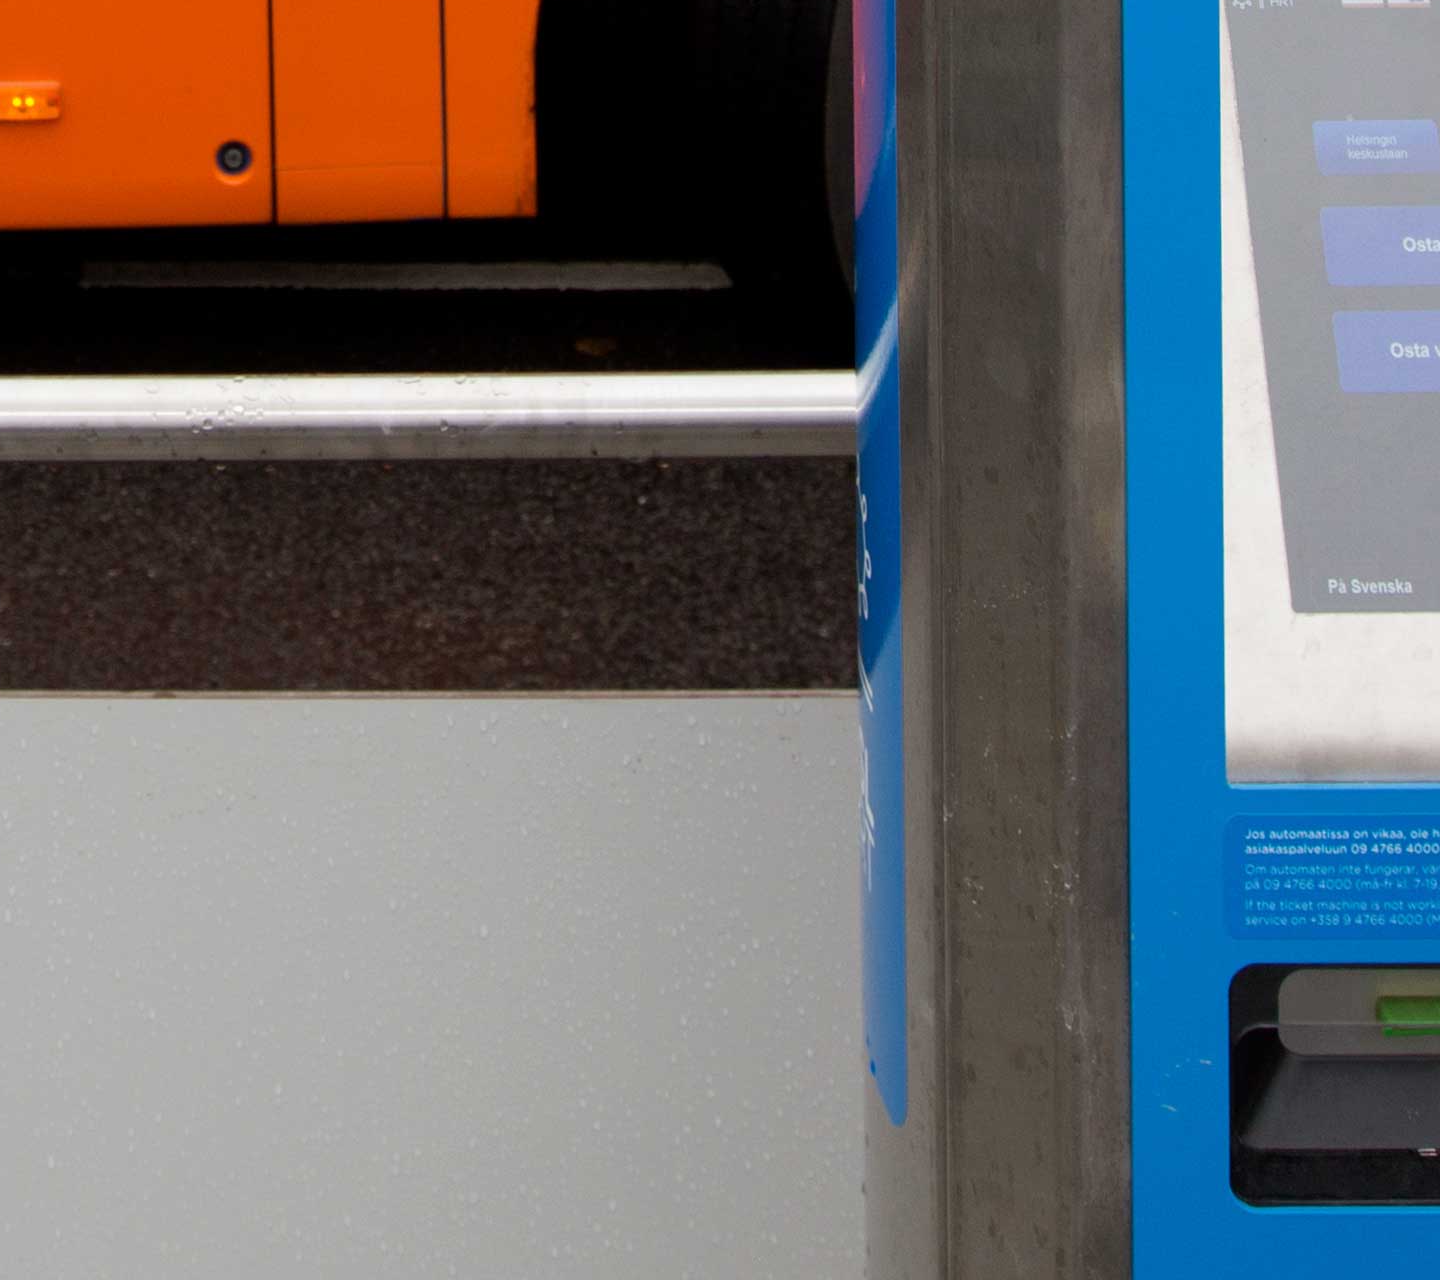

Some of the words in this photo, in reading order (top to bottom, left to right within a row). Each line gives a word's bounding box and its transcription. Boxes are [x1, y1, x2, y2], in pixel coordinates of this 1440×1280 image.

[1346, 135, 1397, 148] Helsingin
[1347, 149, 1408, 160] keskustaan
[1390, 342, 1430, 358] Osta
[1351, 579, 1413, 594] Svenska
[1245, 829, 1265, 841] Jos
[1270, 829, 1349, 841] automaatissa
[1353, 828, 1369, 840] on
[1411, 828, 1428, 840] ole
[1245, 843, 1347, 855] asiakaspalveluun
[1351, 842, 1367, 854] 09
[1371, 842, 1402, 854] 4766
[1406, 842, 1440, 854] 4000
[1245, 900, 1254, 912] If
[1257, 900, 1276, 912] the
[1280, 900, 1312, 912] ticket
[1317, 900, 1367, 912] machine
[1371, 899, 1379, 911] is
[1384, 899, 1404, 911] not
